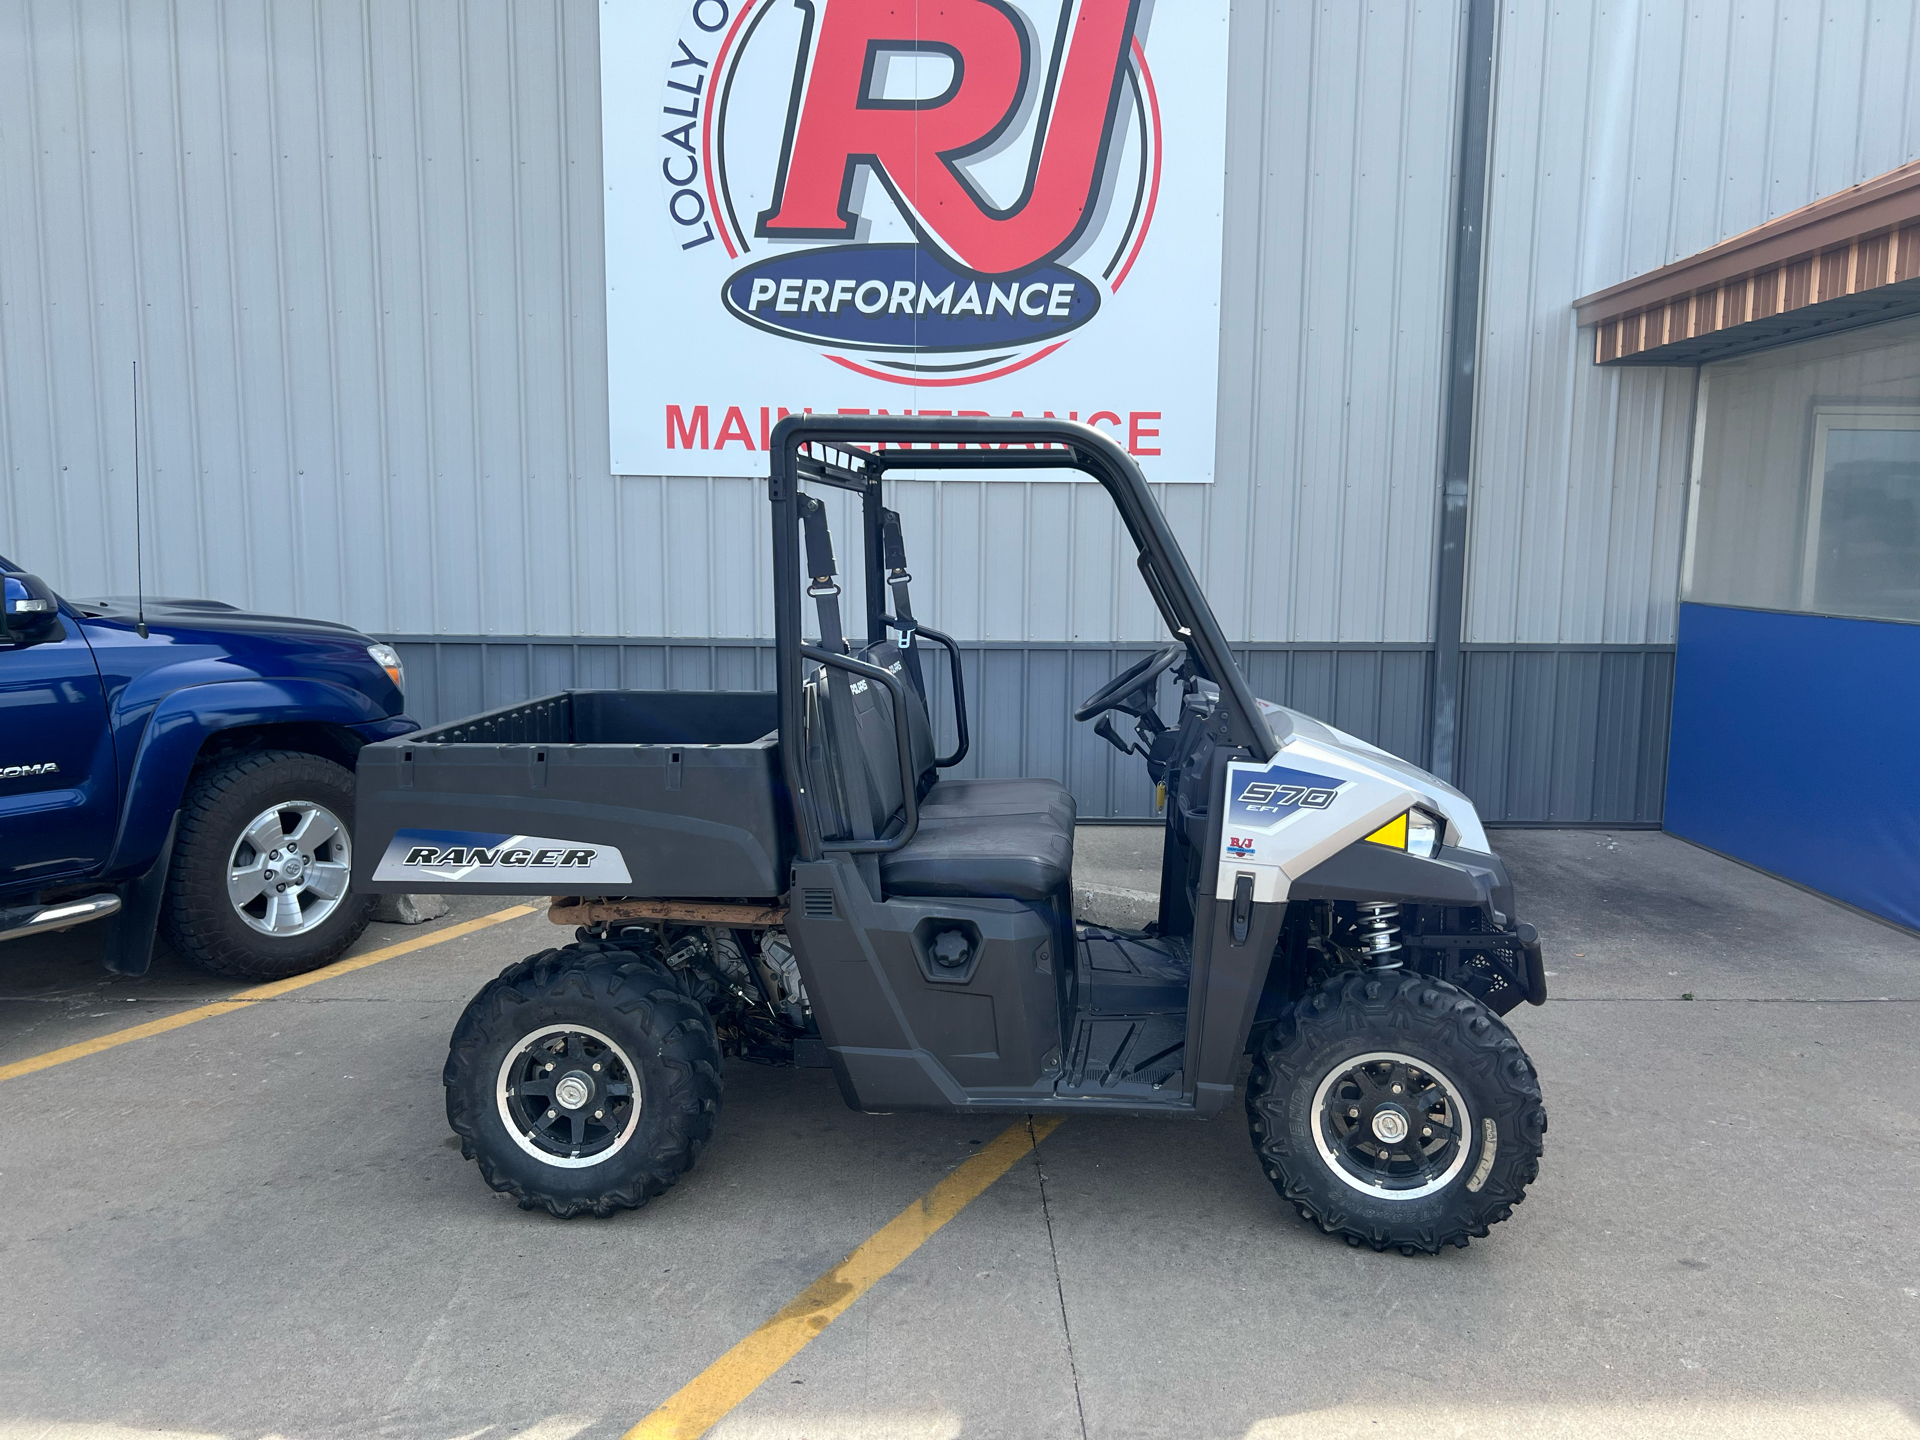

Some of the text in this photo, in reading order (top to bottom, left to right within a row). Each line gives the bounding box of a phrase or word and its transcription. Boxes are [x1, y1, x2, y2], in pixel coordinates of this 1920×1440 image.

[662, 39, 714, 250] LOCALLY
[754, 0, 1139, 281] RJ
[748, 278, 1075, 318] PERFORMANCE
[0, 762, 60, 779] OMA
[1237, 781, 1338, 810] 570
[1246, 805, 1279, 813] EFI
[402, 846, 598, 868] RANGER
[1288, 1076, 1313, 1155] KENDA
